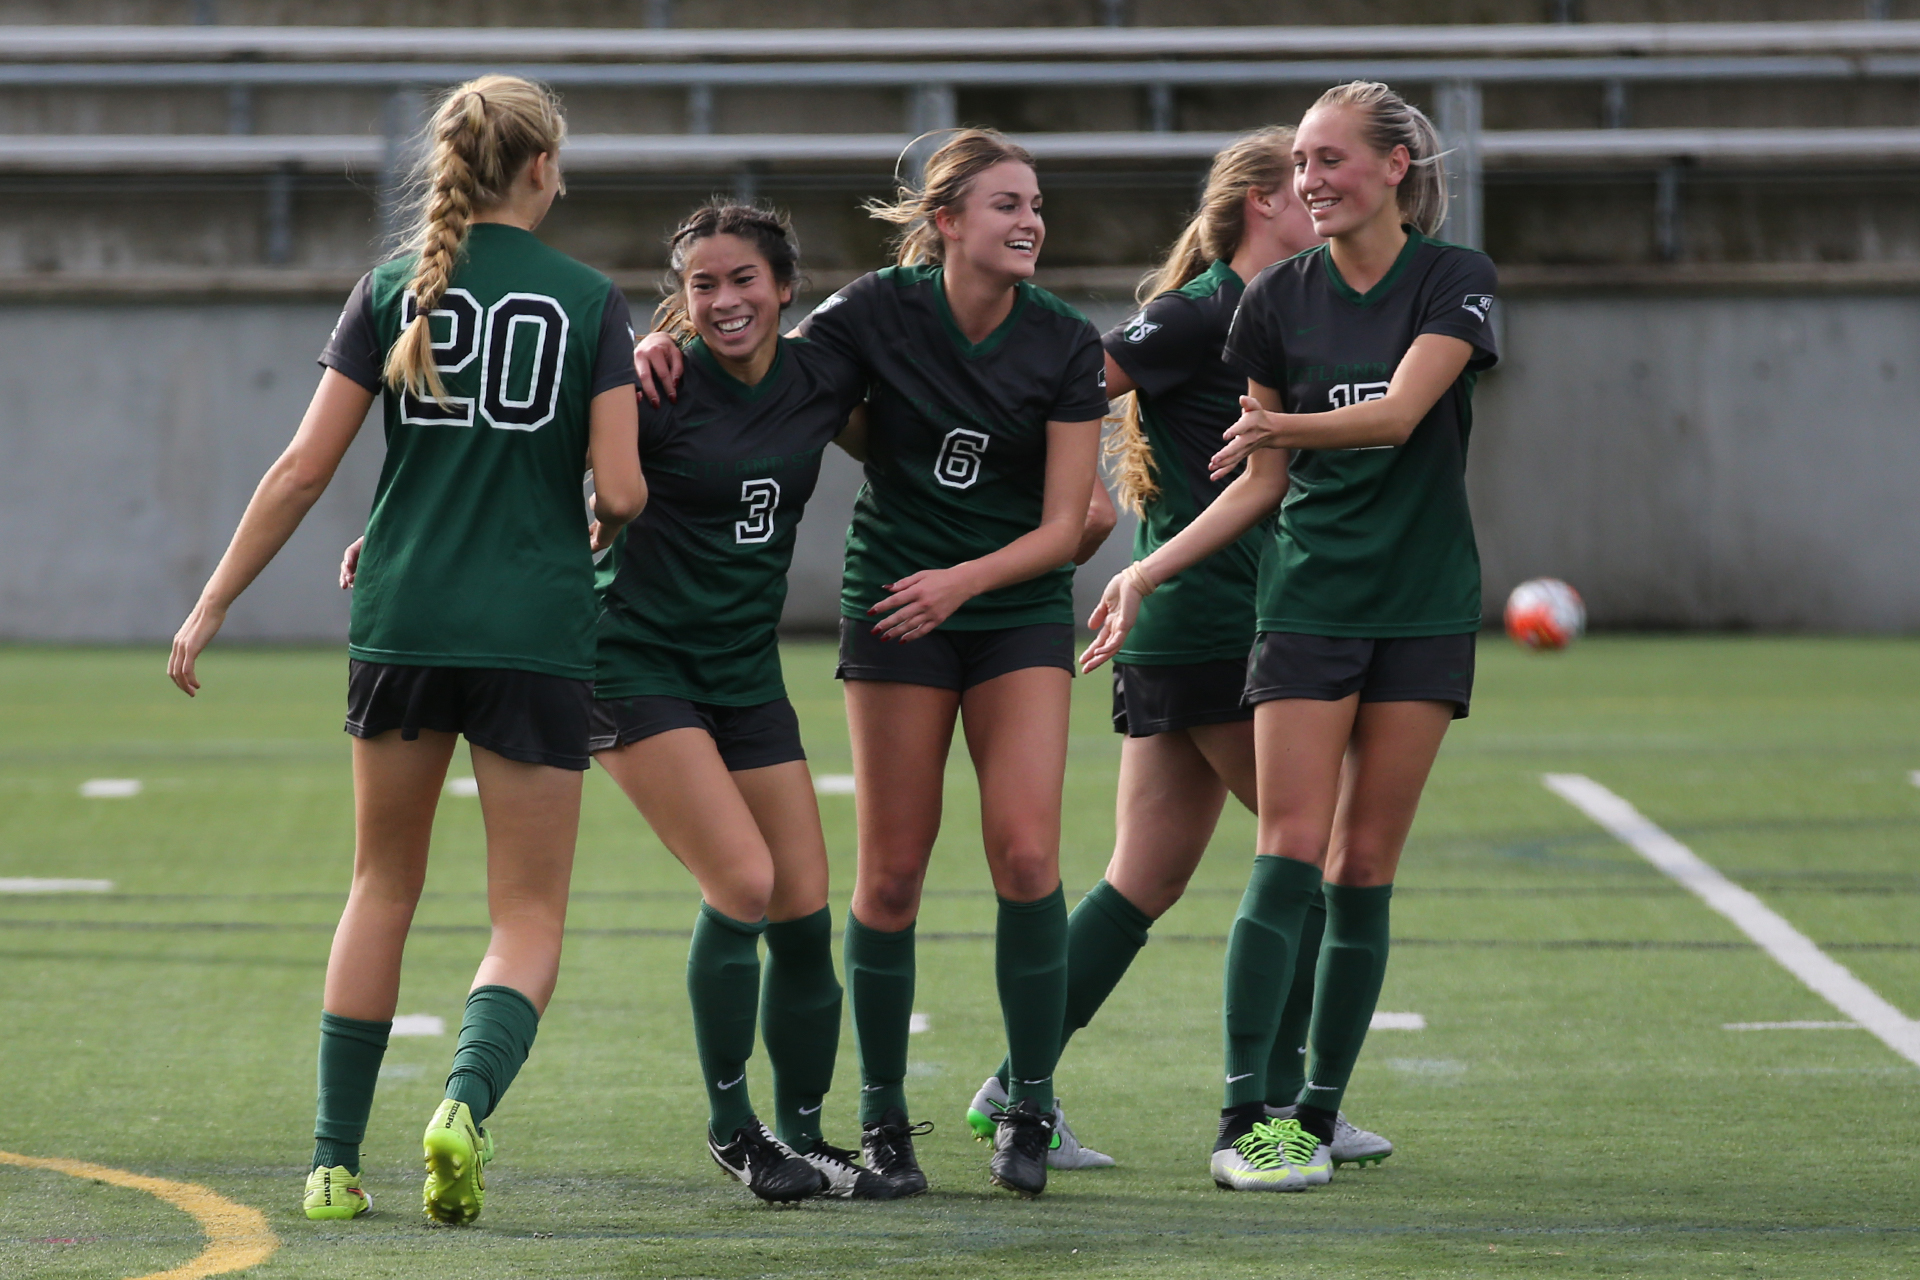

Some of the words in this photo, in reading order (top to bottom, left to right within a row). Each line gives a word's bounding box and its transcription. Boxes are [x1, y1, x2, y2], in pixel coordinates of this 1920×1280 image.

[401, 287, 569, 432] 20
[934, 428, 990, 489] 6
[735, 478, 780, 544] 3
[324, 1171, 332, 1206] TIEMPO
